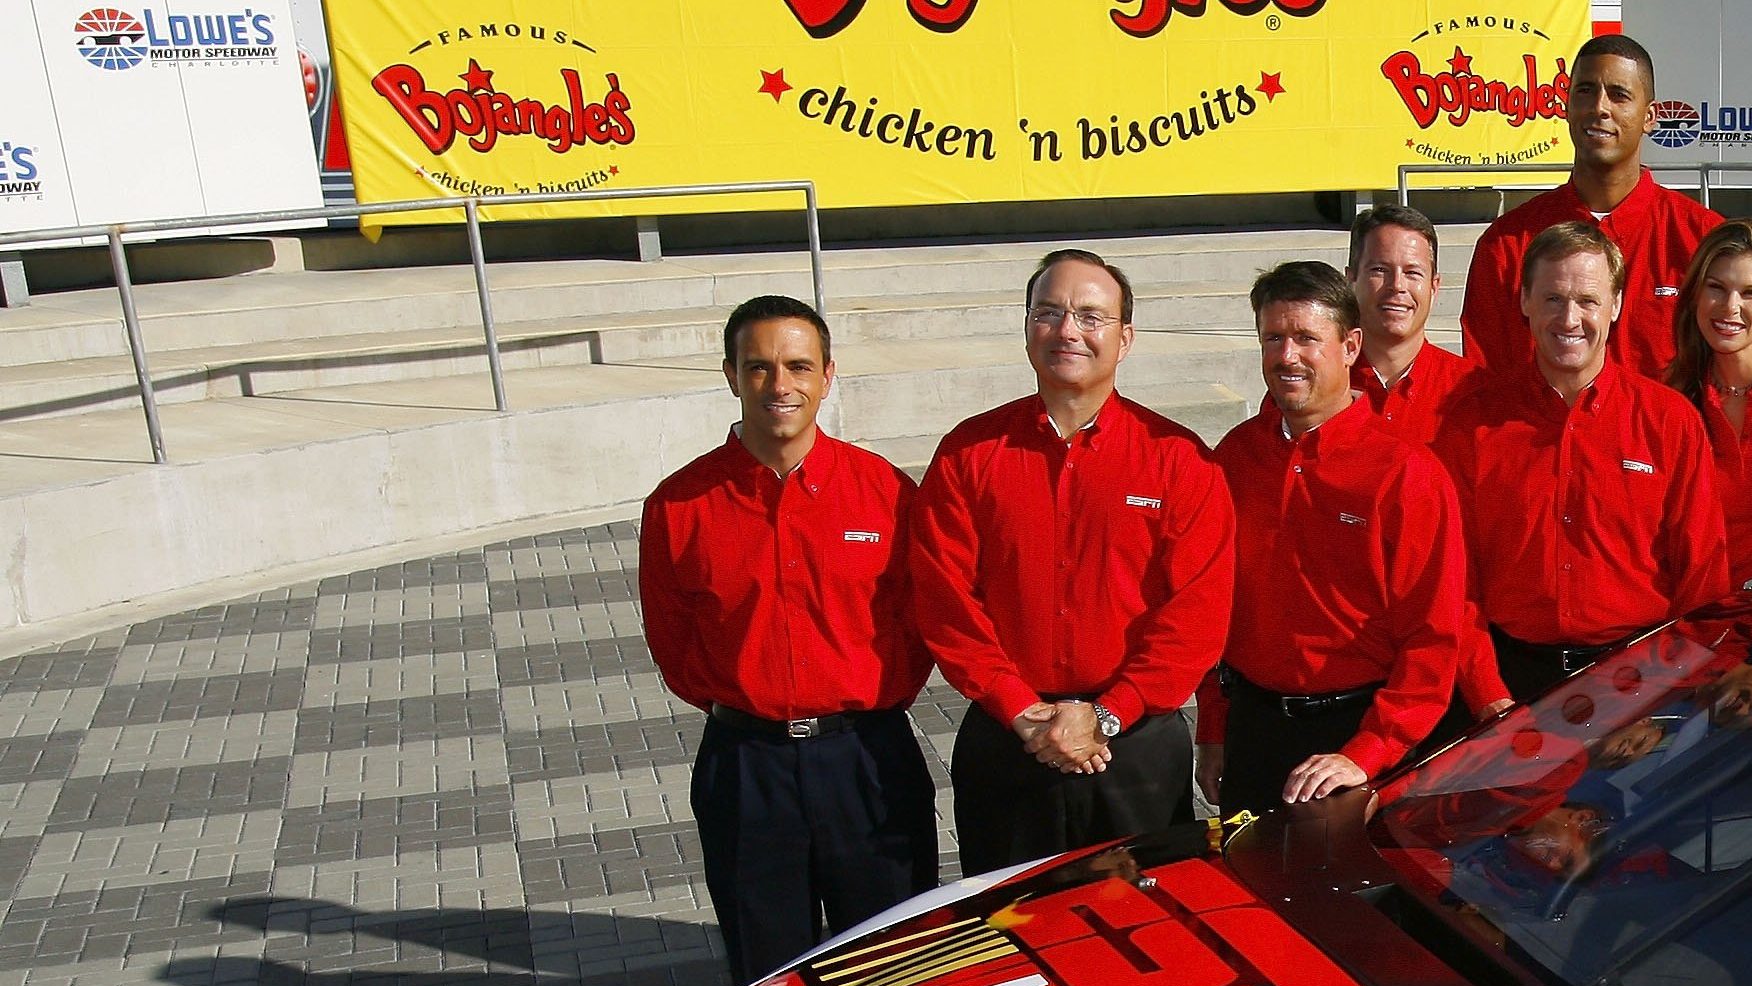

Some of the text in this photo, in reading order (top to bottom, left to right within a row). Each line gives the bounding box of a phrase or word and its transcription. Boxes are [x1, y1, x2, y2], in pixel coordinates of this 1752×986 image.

[143, 8, 275, 46] LOWE'S
[437, 23, 568, 45] FAMOUS
[1433, 16, 1531, 35] FAMOUS
[150, 47, 277, 59] MOTOR SPEEDWAY
[151, 60, 280, 69] CHARLOTTE
[798, 85, 997, 161] chicken
[1077, 82, 1258, 160] biscuits
[1700, 131, 1740, 142] MOTOR
[1415, 143, 1472, 165] chicken
[1496, 141, 1551, 165] biscuits
[430, 170, 505, 196] chicken
[536, 168, 609, 194] biscuits
[1126, 495, 1162, 509] ESPN
[844, 531, 880, 543] ESPN
